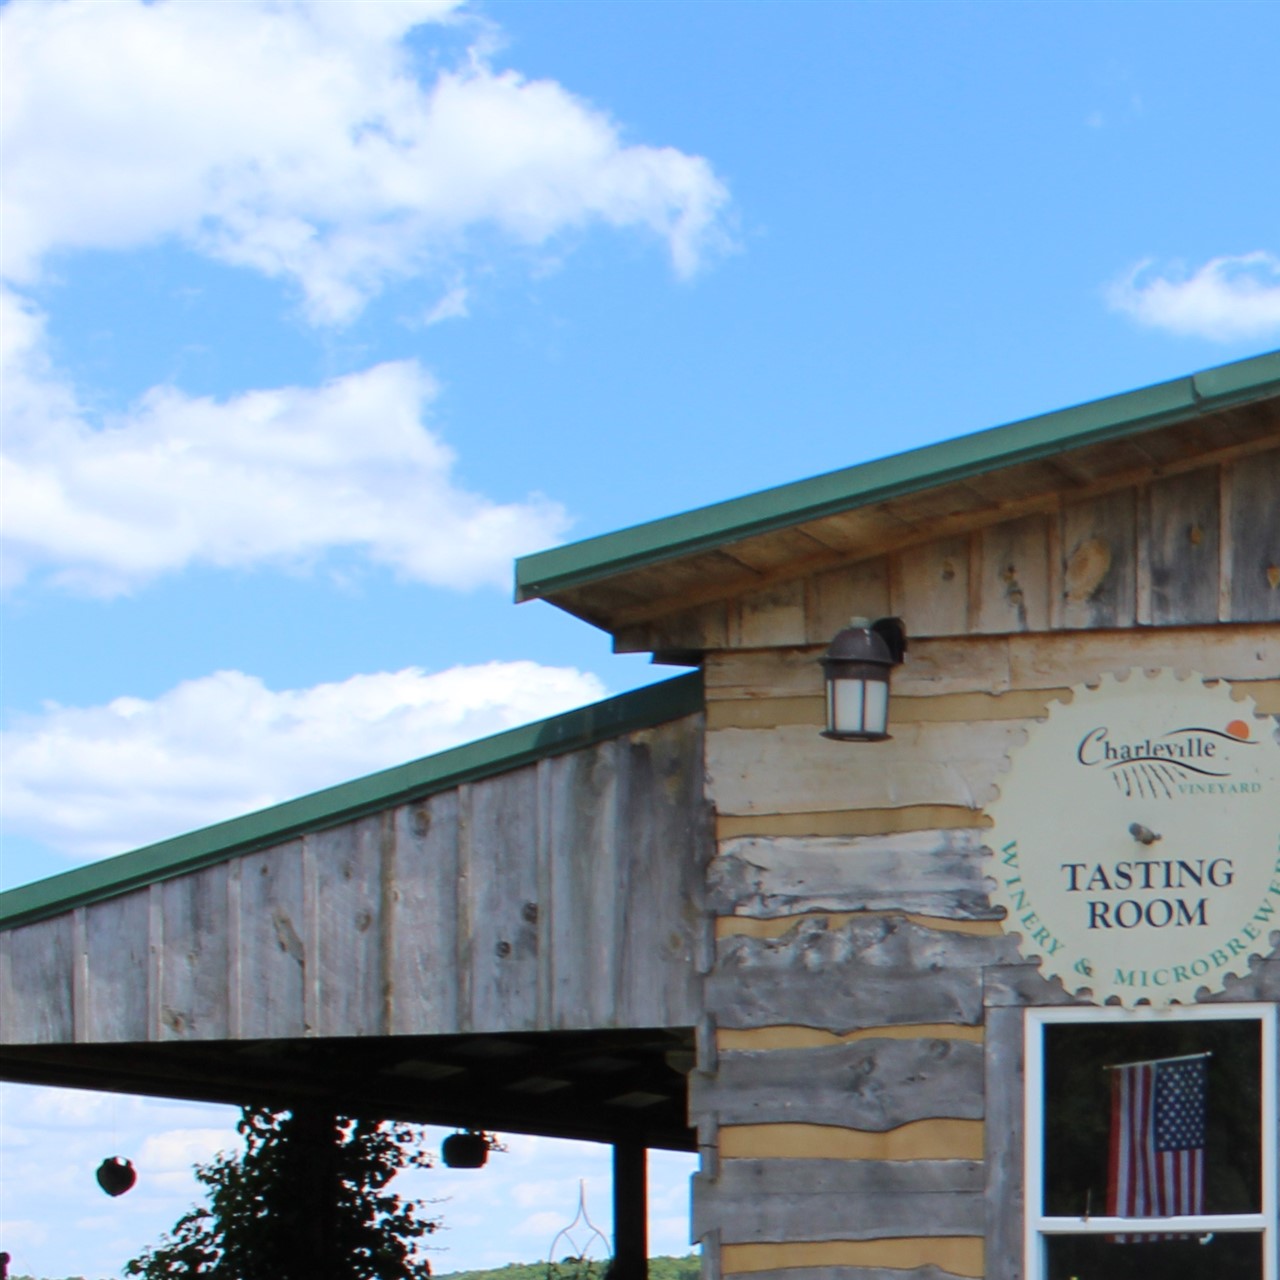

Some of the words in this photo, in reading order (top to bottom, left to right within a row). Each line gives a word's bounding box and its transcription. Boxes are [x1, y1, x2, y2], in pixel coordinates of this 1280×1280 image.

[1077, 726, 1217, 767] Charleville
[1178, 781, 1263, 795] VINEYARD
[1061, 858, 1234, 892] TASTING
[1001, 840, 1066, 957] WINERY
[1073, 957, 1095, 978] &
[1087, 898, 1209, 930] ROOM
